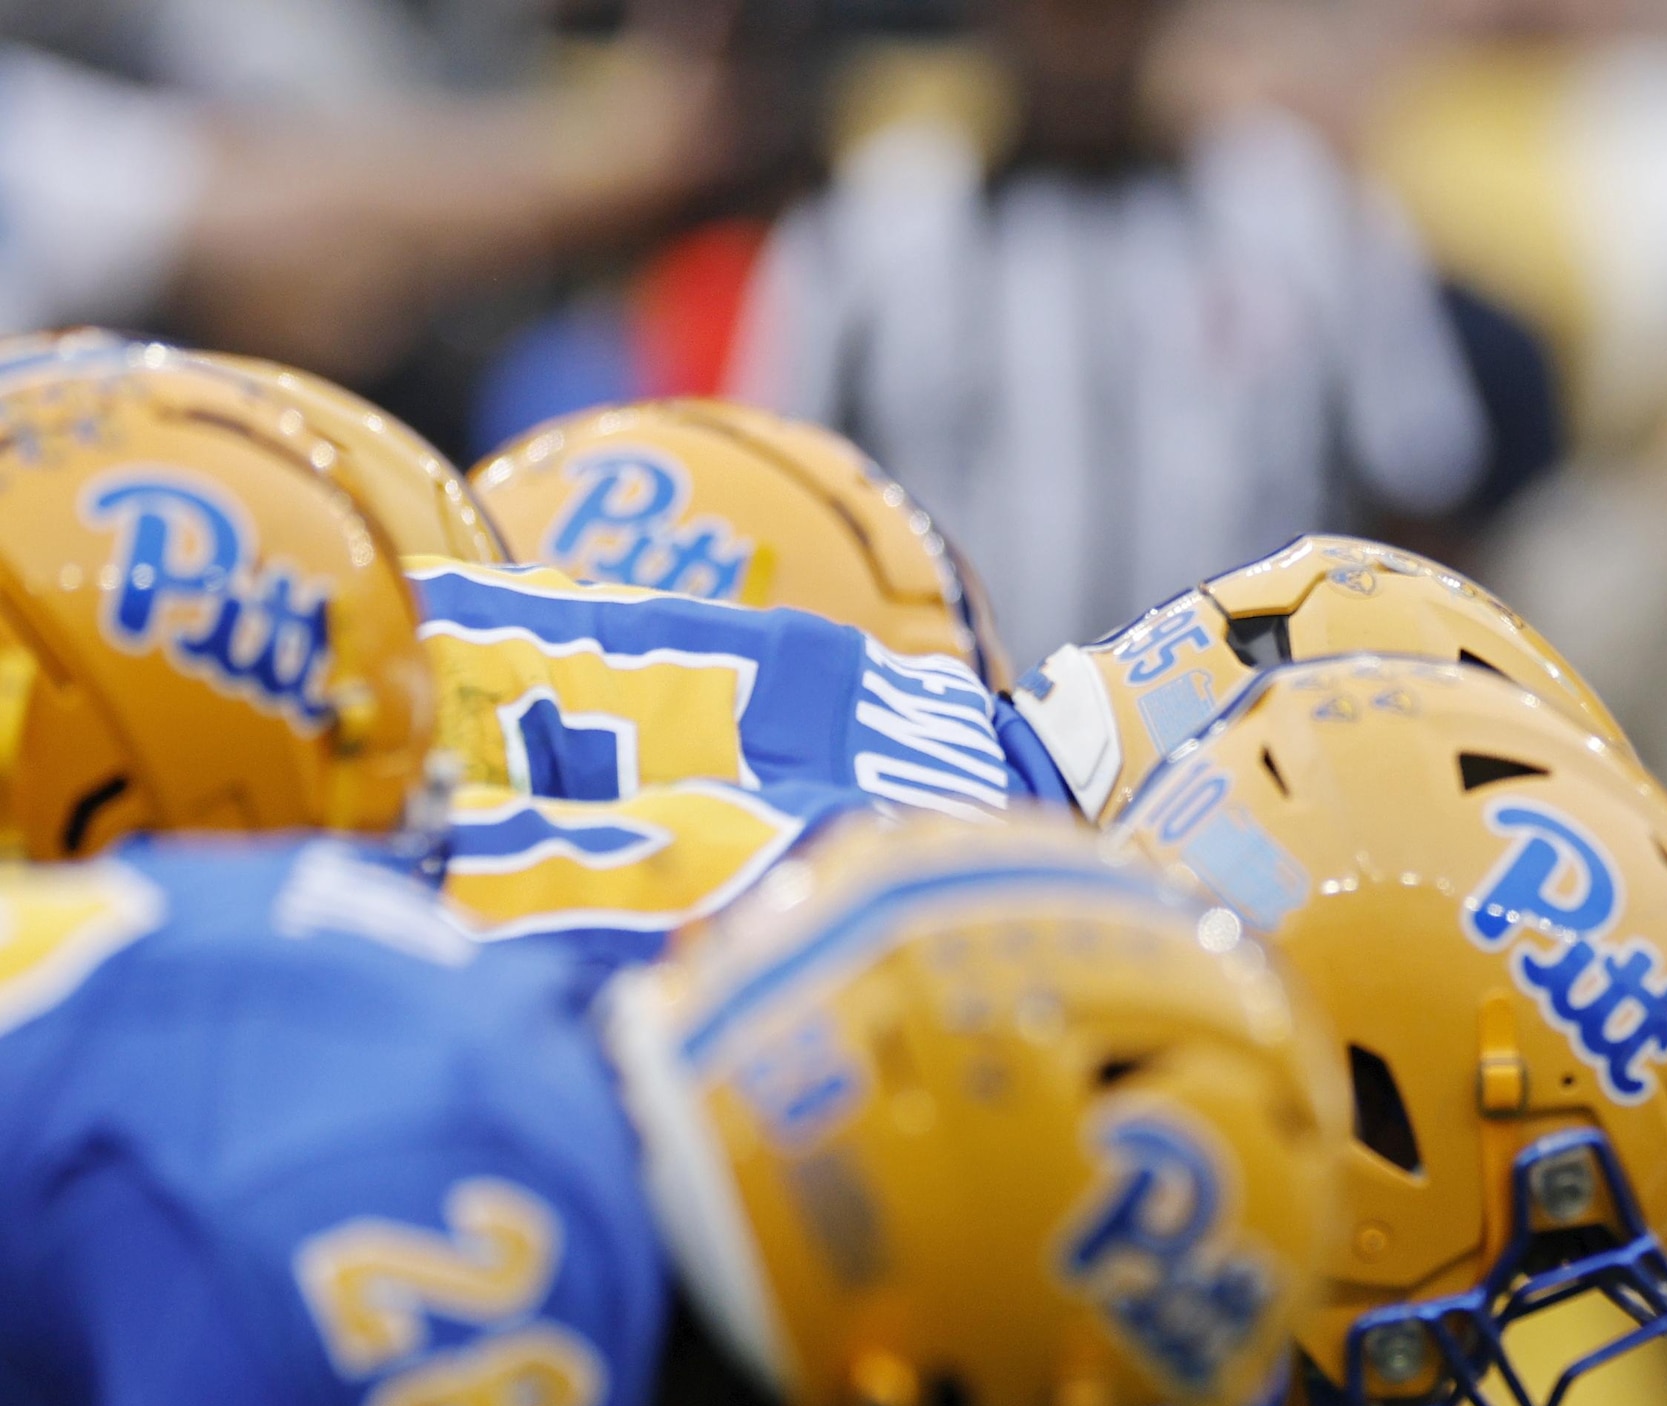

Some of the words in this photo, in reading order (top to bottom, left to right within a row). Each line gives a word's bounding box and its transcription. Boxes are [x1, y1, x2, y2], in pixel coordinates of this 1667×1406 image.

[84, 470, 337, 728] Pitt
[546, 452, 752, 600] Pitt
[1115, 608, 1211, 684] 95
